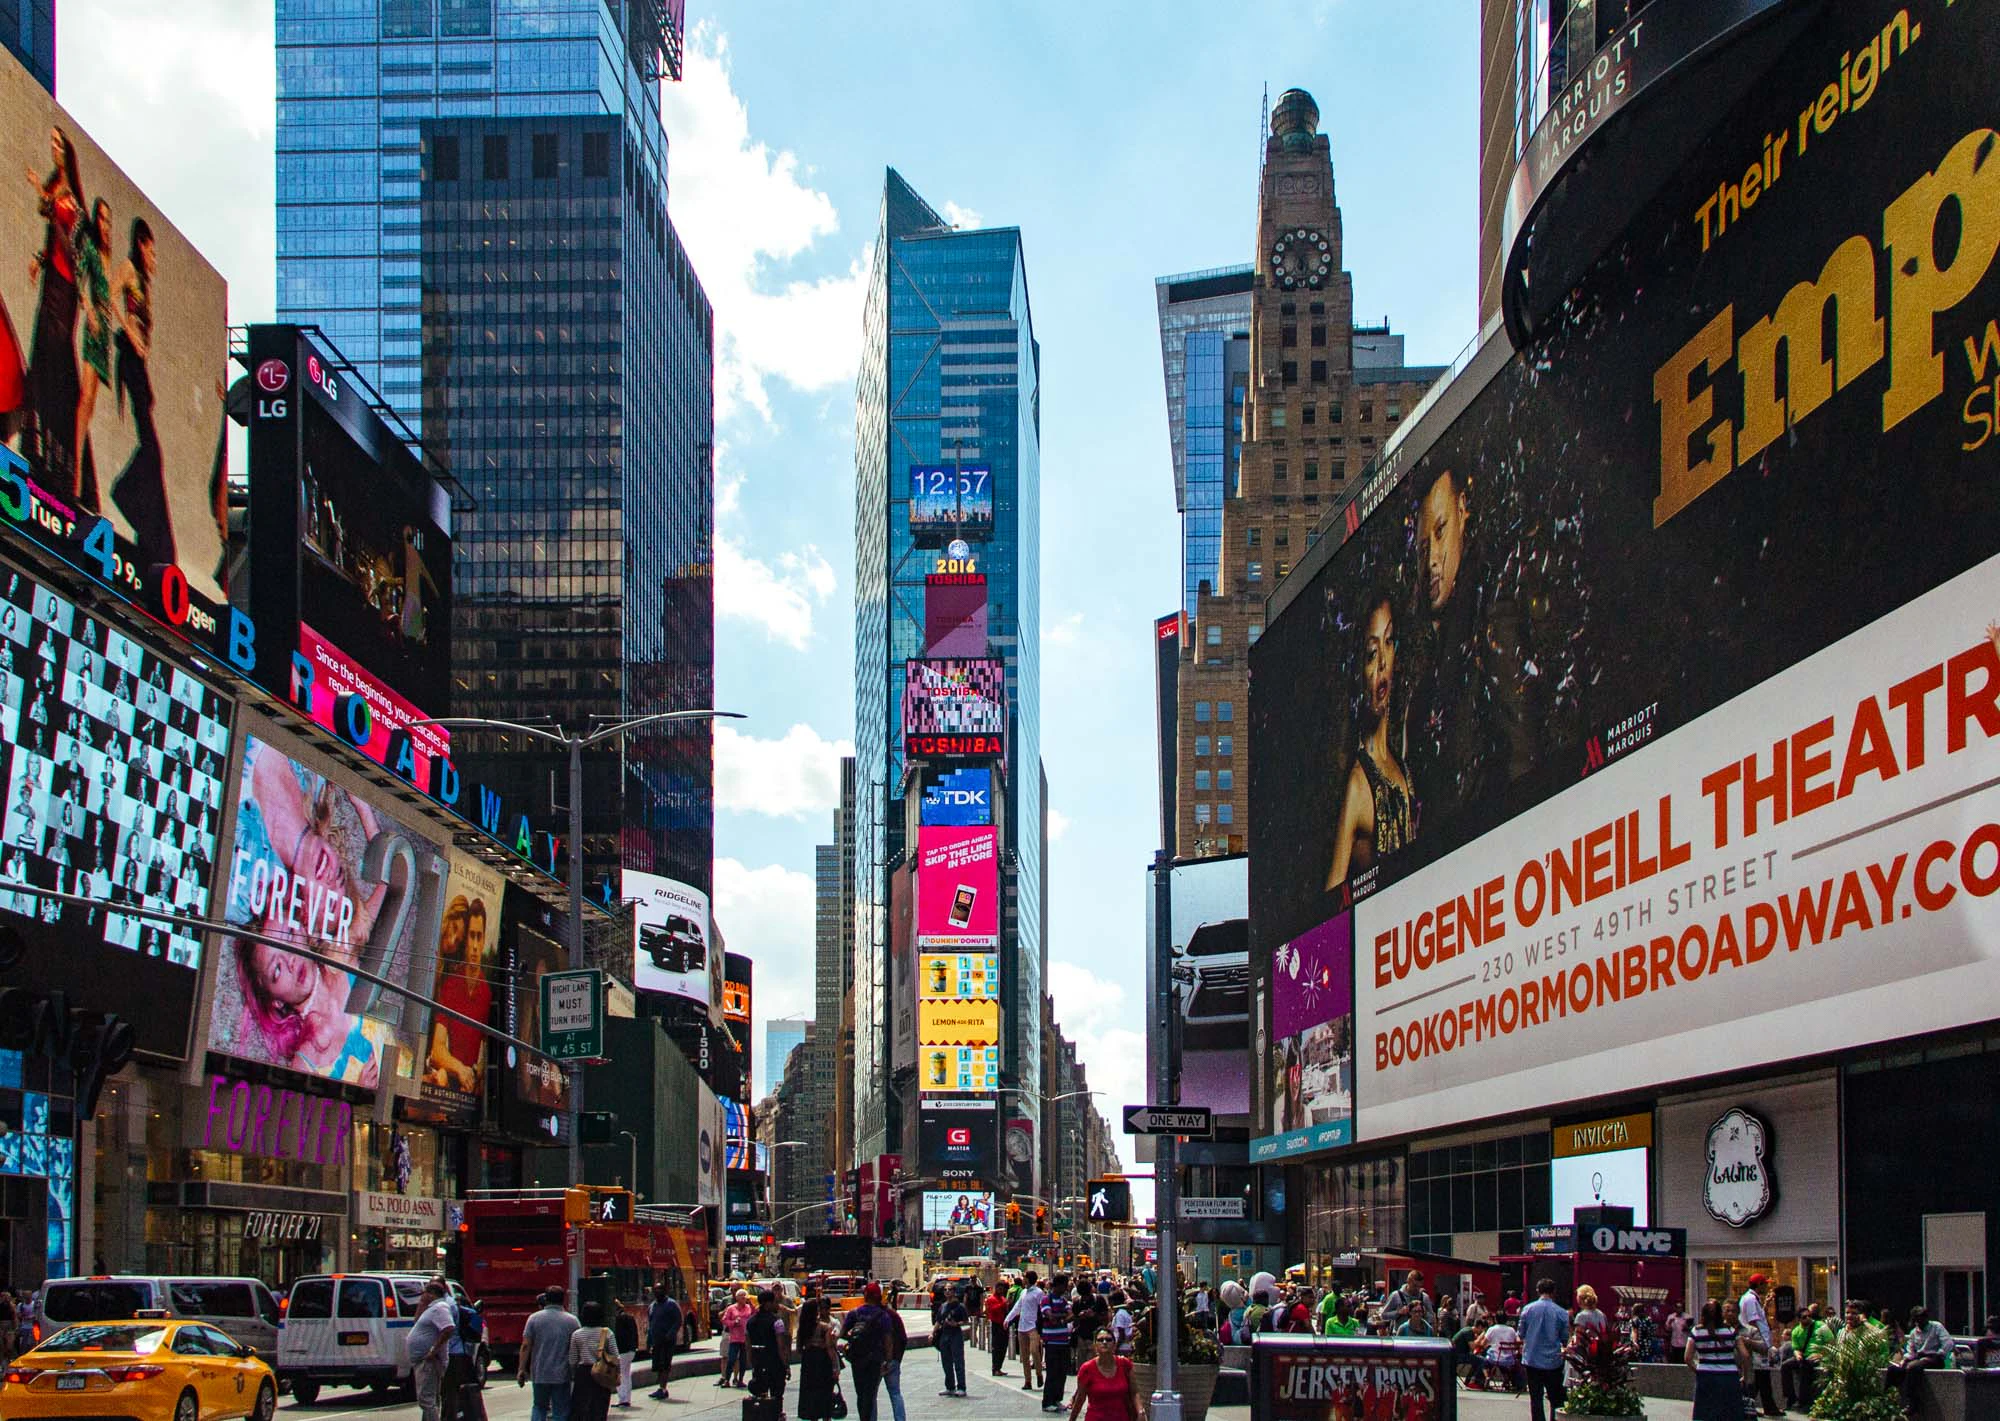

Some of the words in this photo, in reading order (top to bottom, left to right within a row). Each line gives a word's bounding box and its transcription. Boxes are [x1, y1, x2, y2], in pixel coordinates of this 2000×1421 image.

[1540, 21, 1643, 148] MARRIOTT
[1540, 70, 1626, 179] MARQUIS
[1694, 128, 1788, 253] Their
[1799, 9, 1922, 156] reign.
[323, 369, 337, 400] LG
[259, 399, 287, 418] LG
[914, 471, 989, 495] 12:57
[1362, 447, 1403, 503] MARRIOTT
[1362, 472, 1398, 520] MARQUIS
[30, 495, 62, 535] Tue
[936, 559, 976, 574] 2016
[926, 574, 986, 585] TOSHIBA
[316, 644, 338, 672] Since
[340, 664, 354, 685] the
[355, 672, 393, 715] beginning,
[395, 707, 410, 727] your
[1607, 702, 1658, 741] MARRIOTT
[908, 736, 1002, 753] TOSHIBA
[1607, 723, 1652, 758] MARQUIS
[940, 790, 986, 805] TDK
[1375, 875, 1506, 990] EUGENE
[1514, 794, 1692, 928] O'NEILL
[1701, 641, 2000, 850] THEATR
[925, 854, 947, 867] SKIP
[949, 848, 968, 859] THE
[970, 841, 993, 854] LINE
[926, 847, 939, 857] TAP
[949, 840, 970, 850] ORDER
[948, 859, 959, 869] IN
[960, 849, 993, 865] STORE
[465, 868, 482, 887] POLO
[1352, 865, 1379, 889] MARRIOTT
[232, 847, 354, 949] FOREVER
[654, 888, 703, 910] RIDGELINE
[1352, 880, 1376, 899] MARQUIS
[1482, 954, 1514, 985] 230
[1525, 926, 1582, 969] WEST
[1593, 899, 1653, 943] 49TH
[1668, 850, 1779, 917] STREET
[1375, 824, 2000, 1073] BOOKOFMORMONBROADWAY.CO
[552, 984, 571, 993] RIGHT
[572, 982, 590, 993] LANE
[559, 998, 582, 1009] MUST
[551, 1016, 568, 1025] TURN
[570, 1014, 591, 1024] RIGHT
[550, 1046, 559, 1055] W
[562, 1043, 576, 1054] 45
[580, 1042, 592, 1053] ST
[566, 1033, 576, 1041] AT
[700, 1027, 709, 1069] 1500
[526, 1062, 540, 1077] TORY
[204, 1075, 352, 1166] FOREVER
[1150, 1114, 1175, 1126] ONE
[1177, 1114, 1202, 1127] WAY
[1573, 1120, 1629, 1150] INVICTA
[369, 1195, 385, 1212] U.S.
[387, 1197, 411, 1215] POLO
[411, 1200, 436, 1217] ASSN.
[244, 1212, 305, 1239] FOREVER
[305, 1216, 321, 1240] 21
[1531, 1228, 1541, 1238] The
[1541, 1227, 1557, 1238] Official
[1557, 1227, 1571, 1237] Guide
[1618, 1230, 1672, 1251] NYC
[1279, 1364, 1369, 1400] JERSEY
[1376, 1366, 1434, 1402] BOYS
